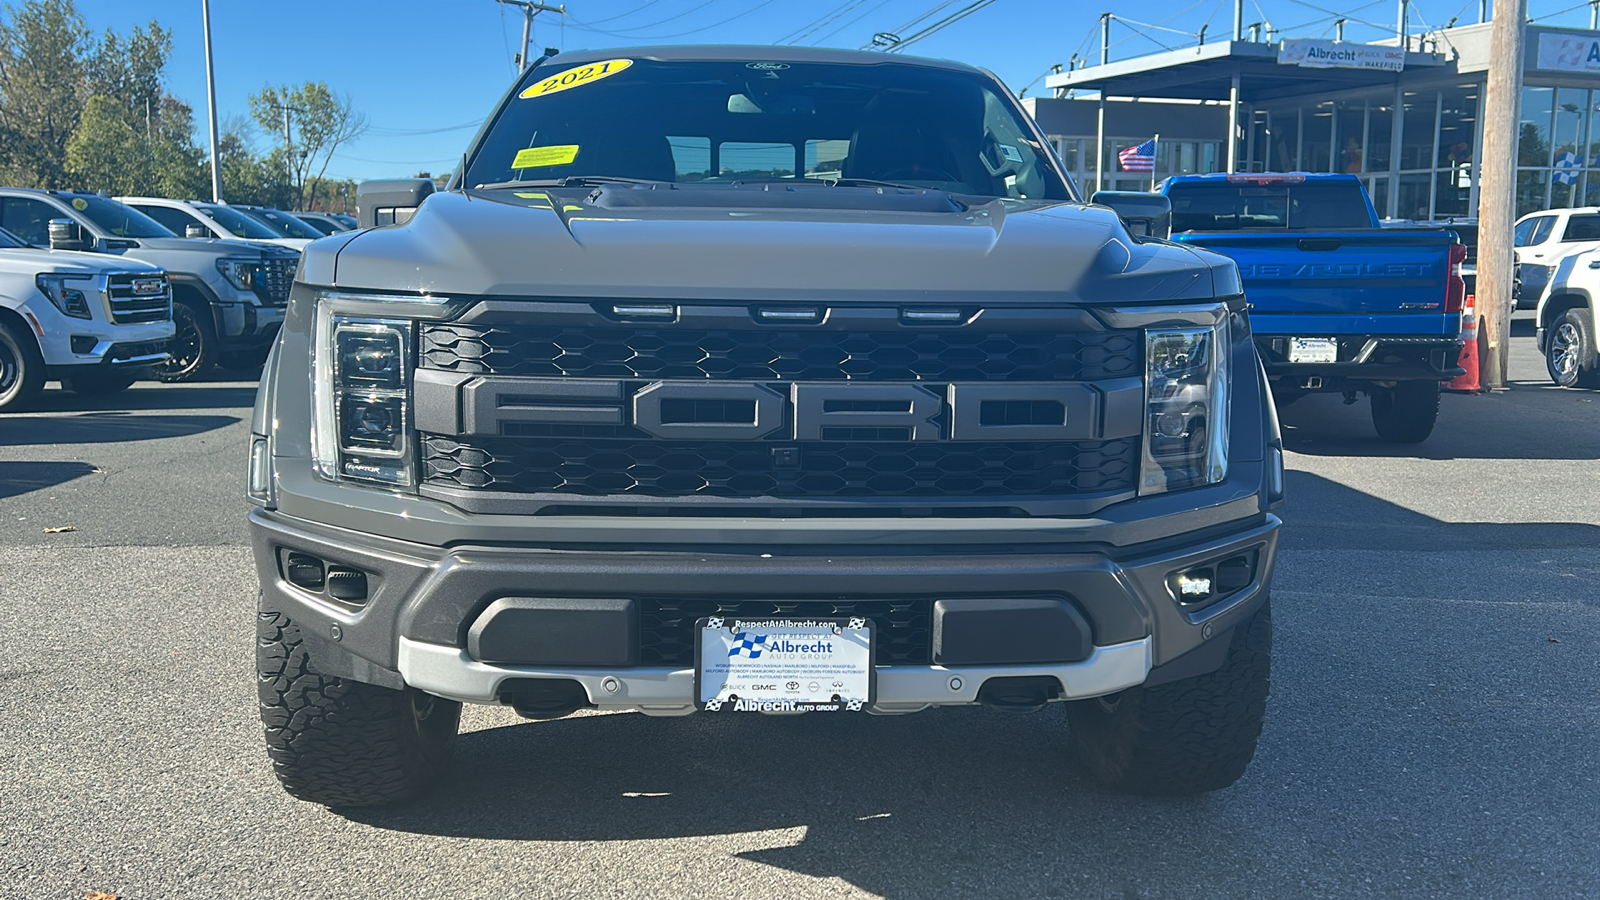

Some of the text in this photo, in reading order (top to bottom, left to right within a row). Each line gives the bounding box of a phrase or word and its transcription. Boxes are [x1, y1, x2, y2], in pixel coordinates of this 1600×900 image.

[1308, 47, 1356, 61] Albrecht
[1365, 61, 1402, 70] WAKEFIELD
[541, 62, 611, 93] 2021
[1237, 262, 1432, 278] HEVROLET
[463, 380, 1103, 441] FORD
[735, 620, 838, 630] RespectAtAlbrecht.com
[769, 640, 833, 653] Albrecht
[733, 698, 796, 712] Albrecht
